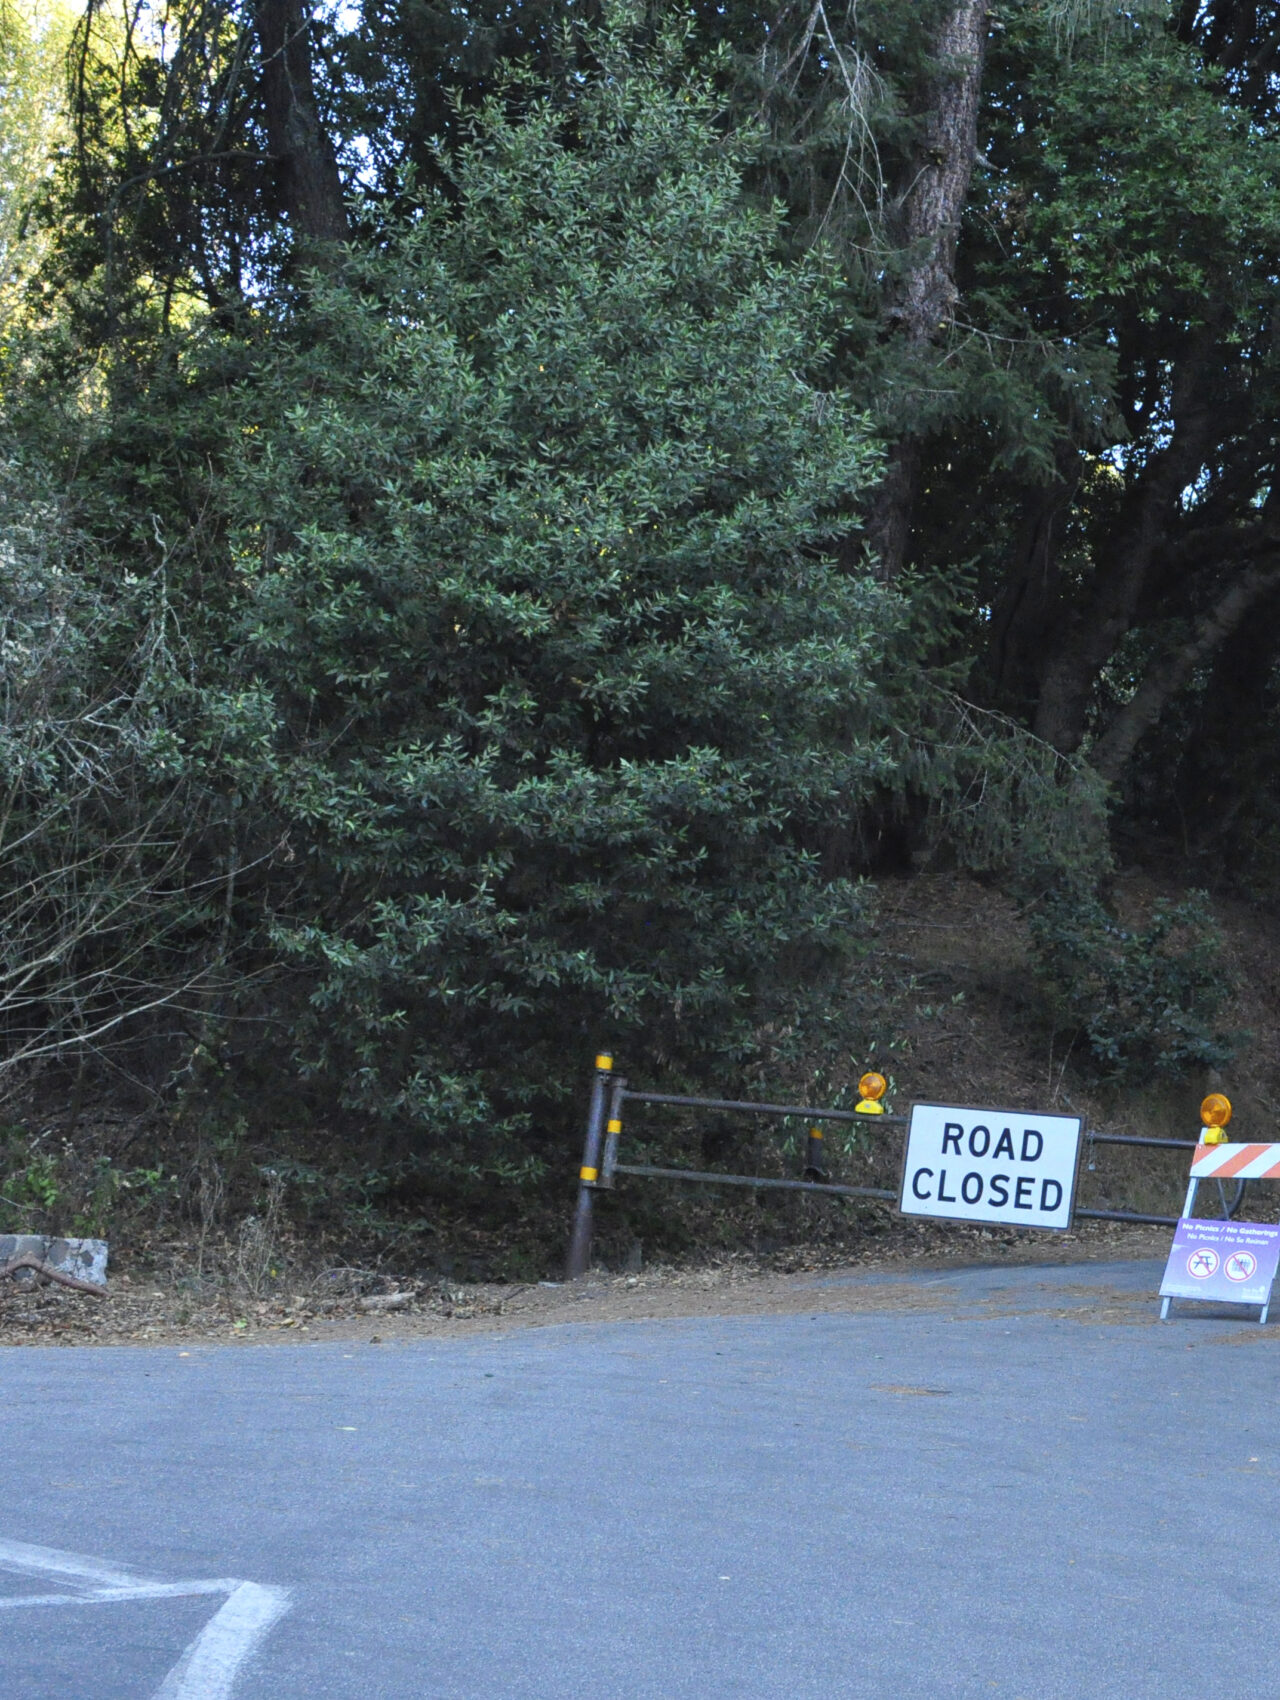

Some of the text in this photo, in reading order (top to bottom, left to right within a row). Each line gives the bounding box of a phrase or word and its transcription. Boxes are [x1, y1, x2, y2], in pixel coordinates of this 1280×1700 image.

[941, 1122, 1044, 1162] ROAD
[912, 1167, 1063, 1212] CLOSED
[1195, 1224, 1219, 1232] Picnics
[1239, 1227, 1278, 1238] Gatherings
